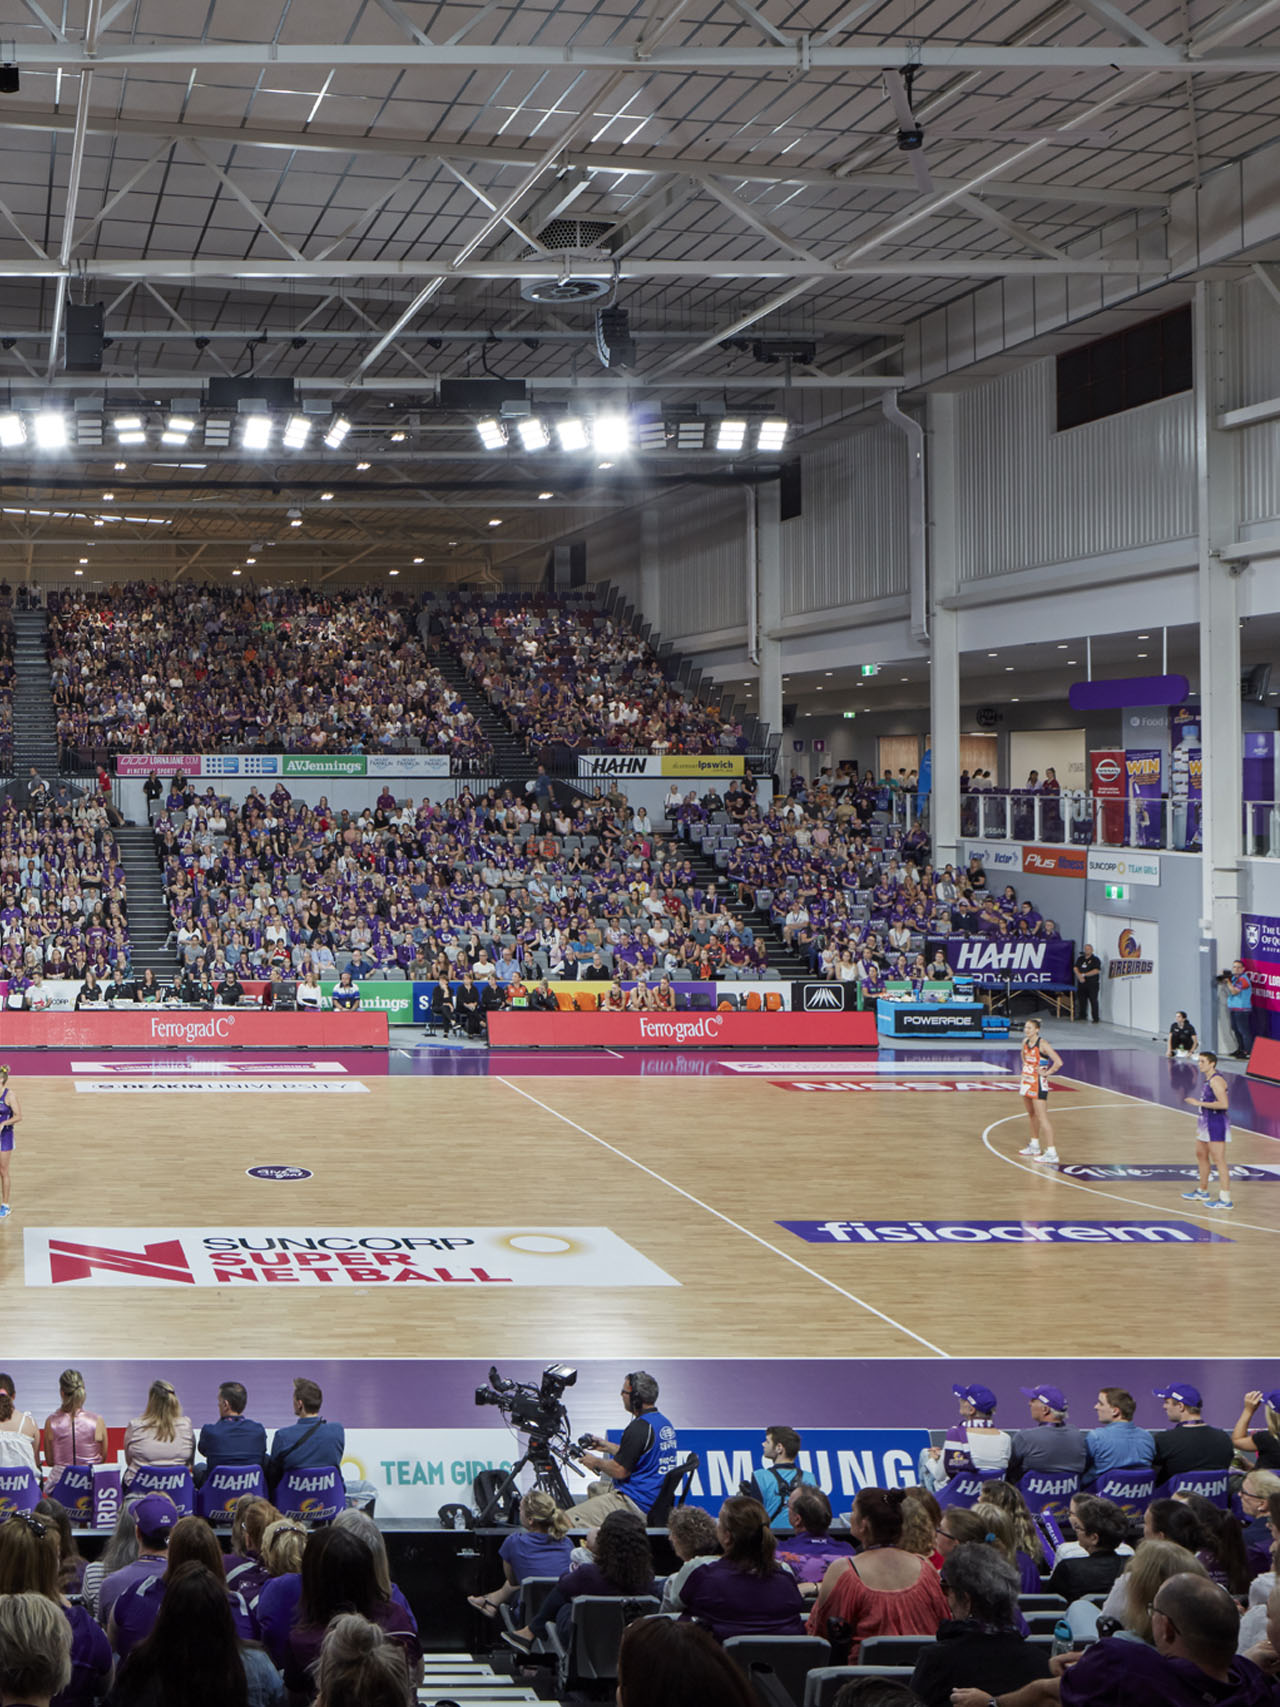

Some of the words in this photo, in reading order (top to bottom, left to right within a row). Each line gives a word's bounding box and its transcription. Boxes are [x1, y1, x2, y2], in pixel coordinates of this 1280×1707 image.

[1142, 717, 1164, 726] Food
[150, 756, 199, 765] LORNAJANE.COM
[287, 760, 362, 773] AVJennings
[592, 758, 647, 773] HAHN
[698, 760, 733, 770] Ipswich
[1126, 758, 1160, 775] WIN
[994, 852, 1012, 864] Victor
[1025, 854, 1056, 869] Plus
[1058, 856, 1084, 870] fitness
[1089, 861, 1117, 871] SUNCORP
[1128, 864, 1142, 874] TEAM
[1144, 865, 1158, 875] GIRLS
[957, 943, 1047, 969] HAHN
[1108, 959, 1154, 979] FIREBIRDS
[817, 1222, 1201, 1242] fisiocrem
[202, 1237, 475, 1251] SUNCORP
[209, 1252, 412, 1267] SUPER
[213, 1267, 513, 1283] NETBALL
[380, 1460, 444, 1485] TEAM
[675, 1450, 918, 1497] AMUNG
[136, 1472, 185, 1490] HAHN
[212, 1471, 260, 1491] HAHN
[288, 1472, 335, 1492] HAHN
[1028, 1475, 1078, 1494] HAHN
[1104, 1477, 1154, 1498] HAHN
[1178, 1477, 1227, 1496] HAHN
[287, 1506, 337, 1519] FIREBIRDS
